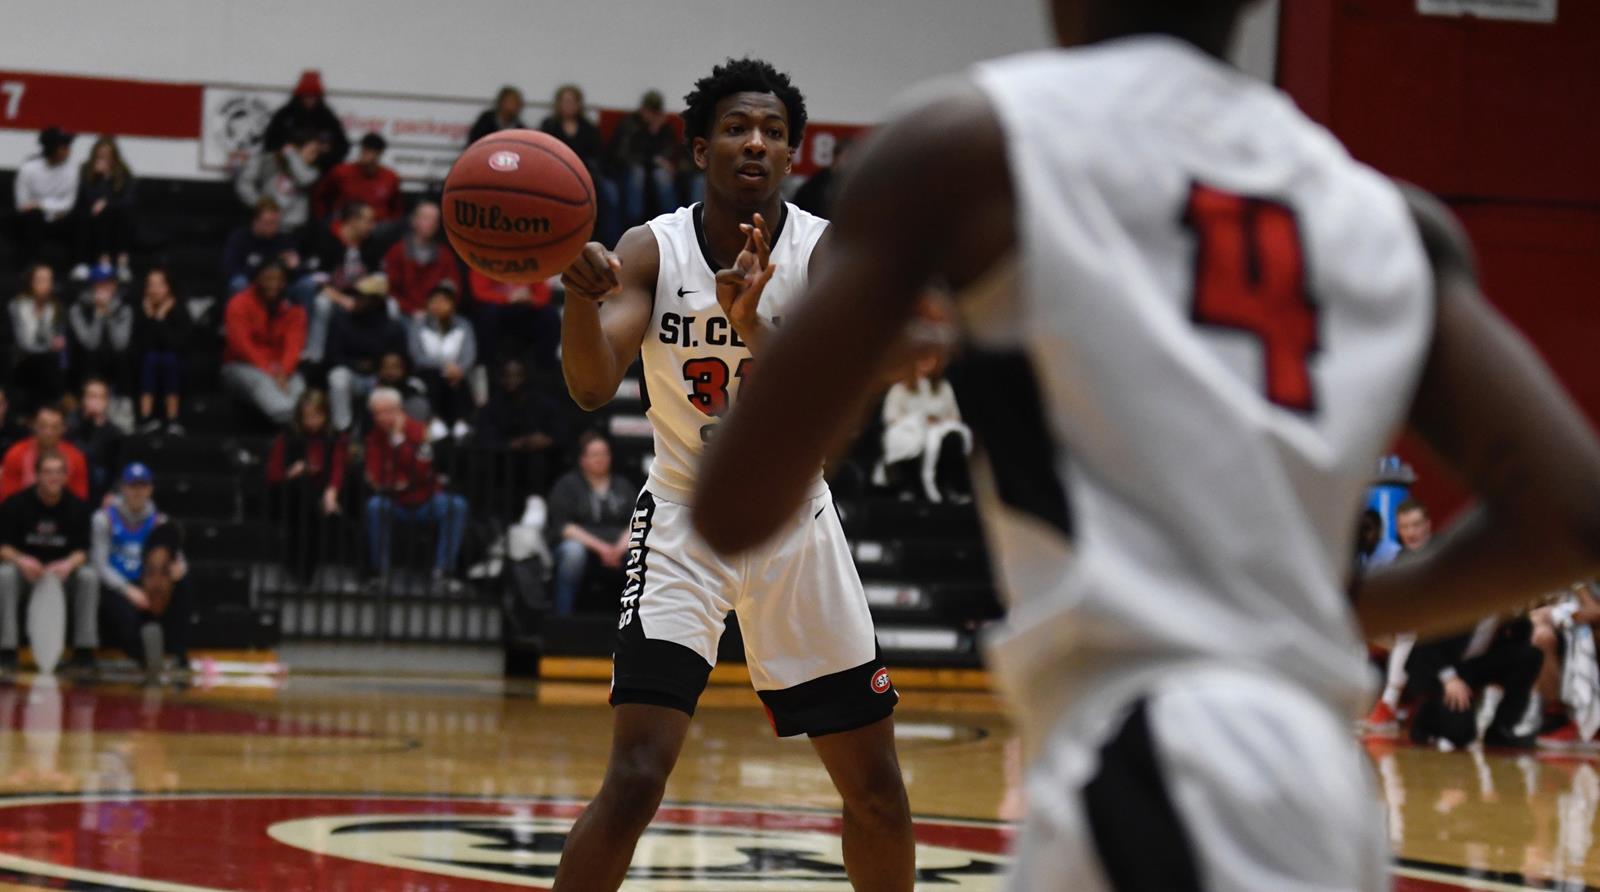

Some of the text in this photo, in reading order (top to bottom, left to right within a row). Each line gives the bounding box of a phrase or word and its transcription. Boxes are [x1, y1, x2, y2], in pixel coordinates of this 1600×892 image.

[1, 81, 26, 119] 7
[454, 199, 552, 233] Wilson
[1183, 179, 1321, 414] 4
[660, 312, 699, 347] ST.
